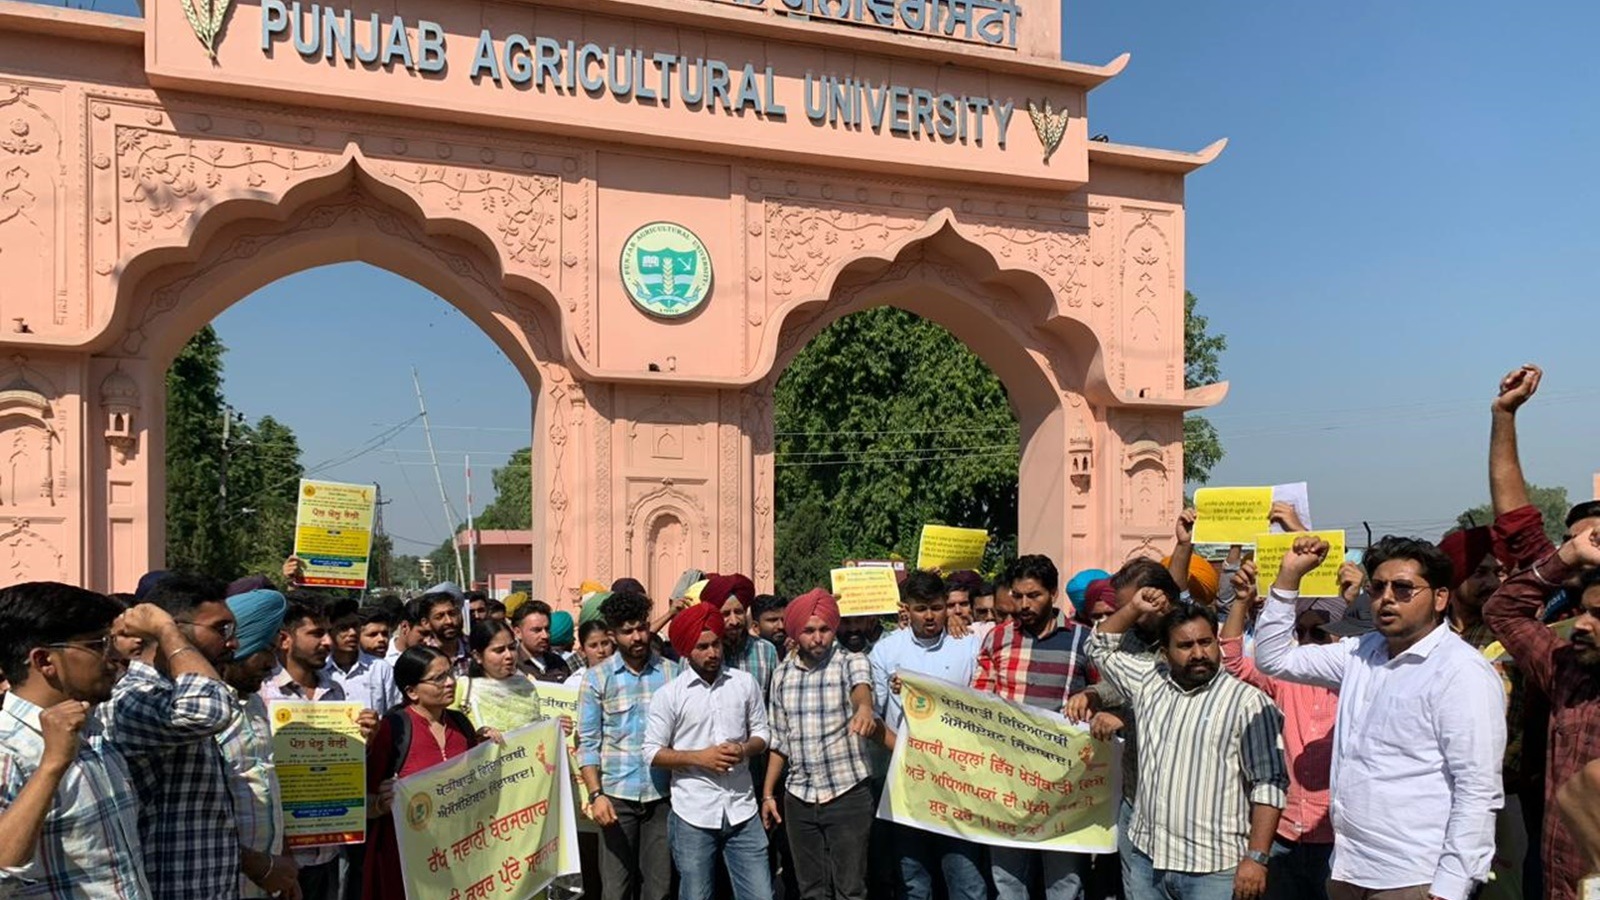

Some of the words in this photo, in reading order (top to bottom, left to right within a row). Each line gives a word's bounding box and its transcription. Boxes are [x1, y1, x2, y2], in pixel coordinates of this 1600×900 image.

[260, 0, 447, 74] PUNJAB
[470, 29, 787, 119] AGRICULTURAL
[804, 72, 1014, 149] UNIVERSITY
[908, 736, 944, 760] ਰਕਾਰੀ
[1002, 790, 1018, 809] ਦੀ
